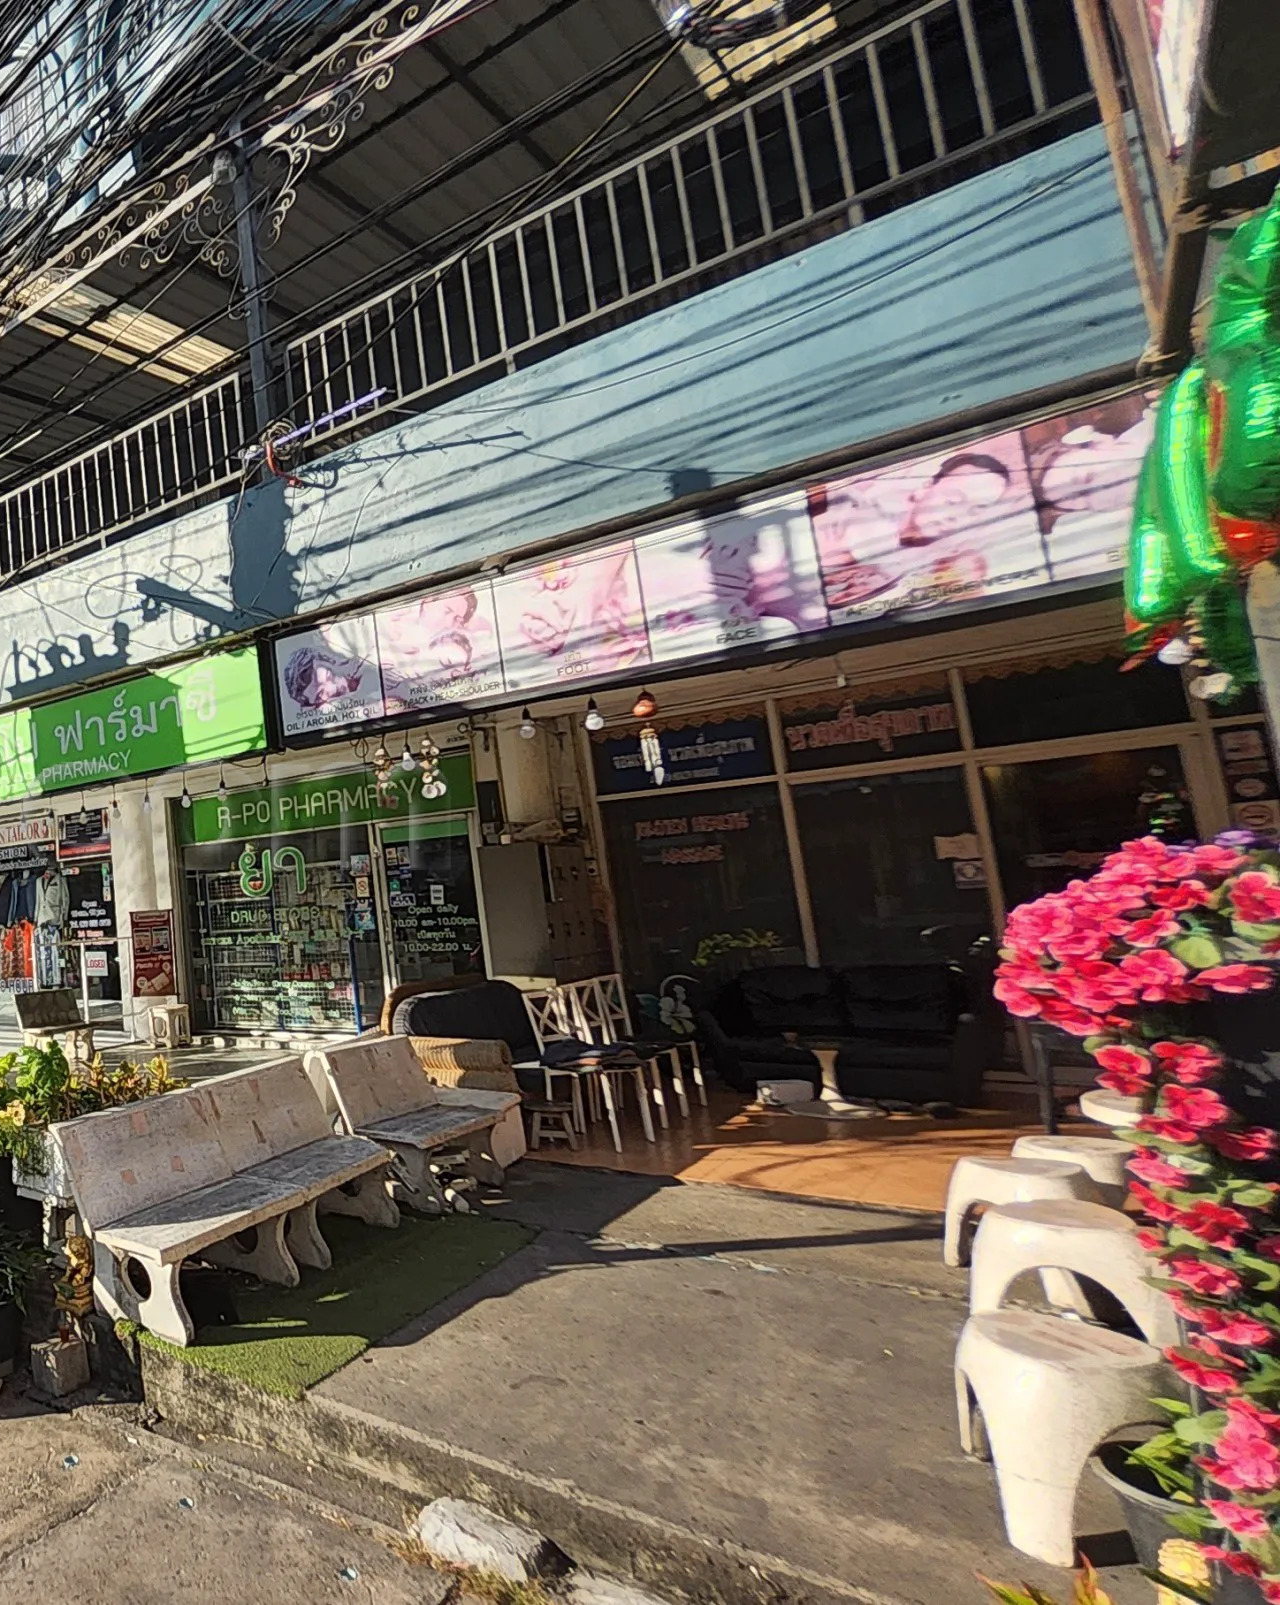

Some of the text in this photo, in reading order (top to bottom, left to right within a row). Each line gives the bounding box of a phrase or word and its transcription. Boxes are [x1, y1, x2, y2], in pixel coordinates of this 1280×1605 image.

[716, 627, 757, 644] FACE
[557, 660, 592, 677] FOOT
[341, 709, 361, 721] HOT
[364, 706, 379, 719] OIL
[42, 749, 132, 786] PHARMACY
[279, 777, 417, 821] PHARMACY
[238, 846, 307, 898] ยา
[408, 906, 433, 916] Open
[87, 959, 106, 969] LOSED
